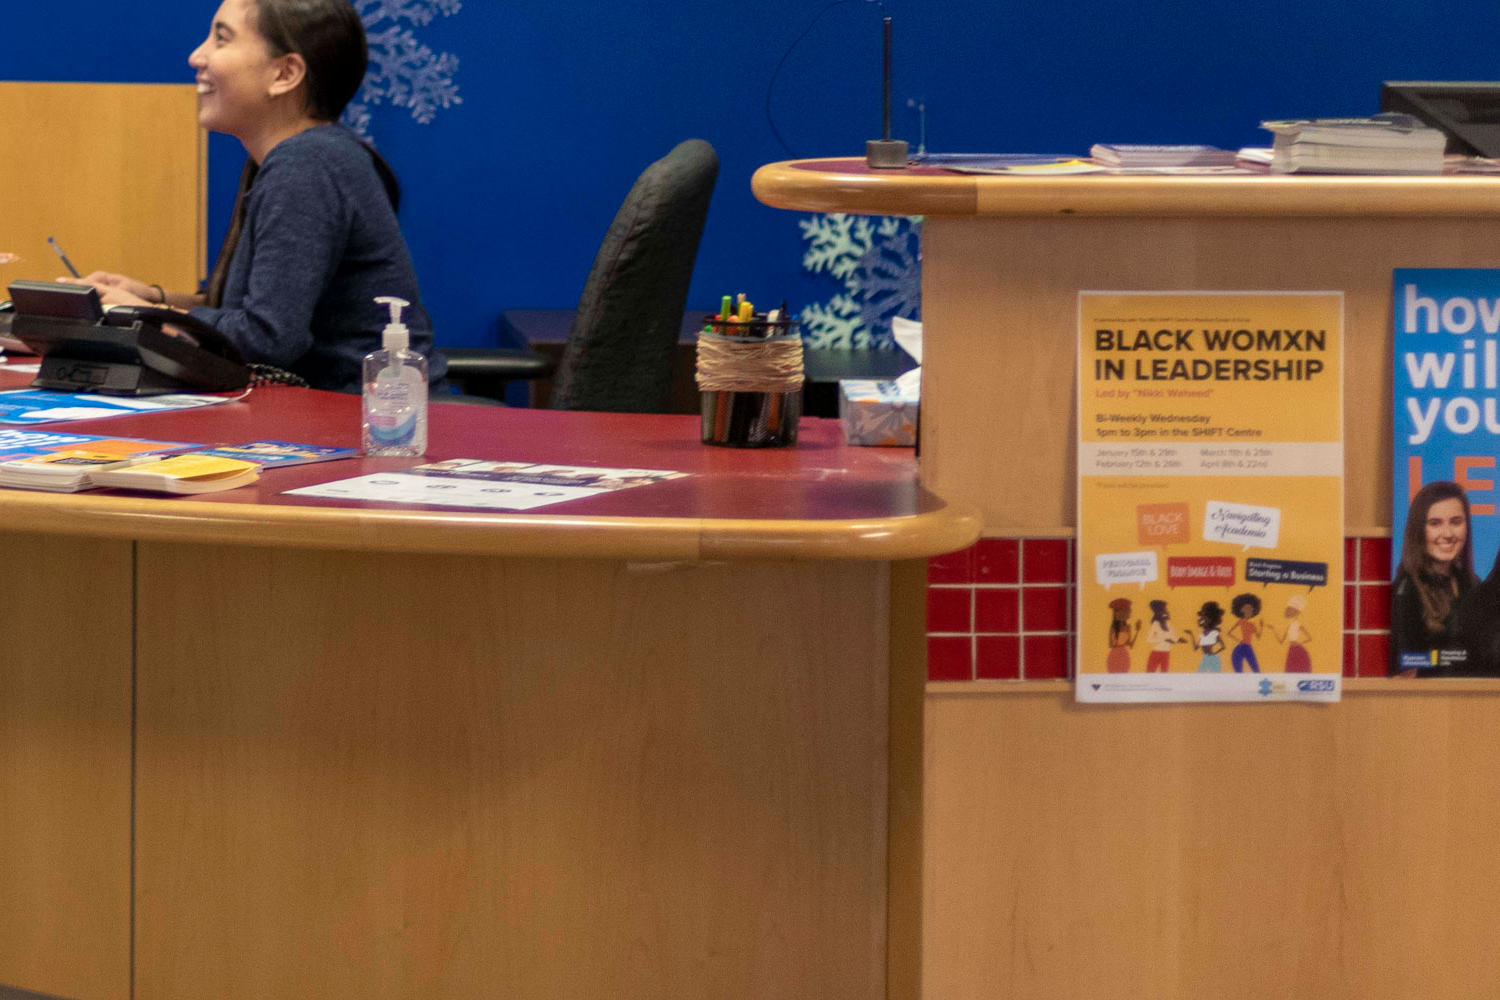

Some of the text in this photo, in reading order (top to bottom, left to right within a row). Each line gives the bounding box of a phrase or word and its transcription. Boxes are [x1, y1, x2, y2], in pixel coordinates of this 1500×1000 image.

[1094, 329, 1327, 351] BLACK WOMXN
[1094, 359, 1324, 381] IN LEADERSHIP
[1150, 414, 1211, 424] Wednesday
[1120, 429, 1131, 437] to
[1172, 428, 1189, 437] the
[1192, 428, 1223, 437] SHIFT
[1226, 428, 1263, 437] Centre
[1142, 512, 1183, 525] BLACK
[1211, 508, 1271, 527] Navigating
[1214, 523, 1267, 538] Academia
